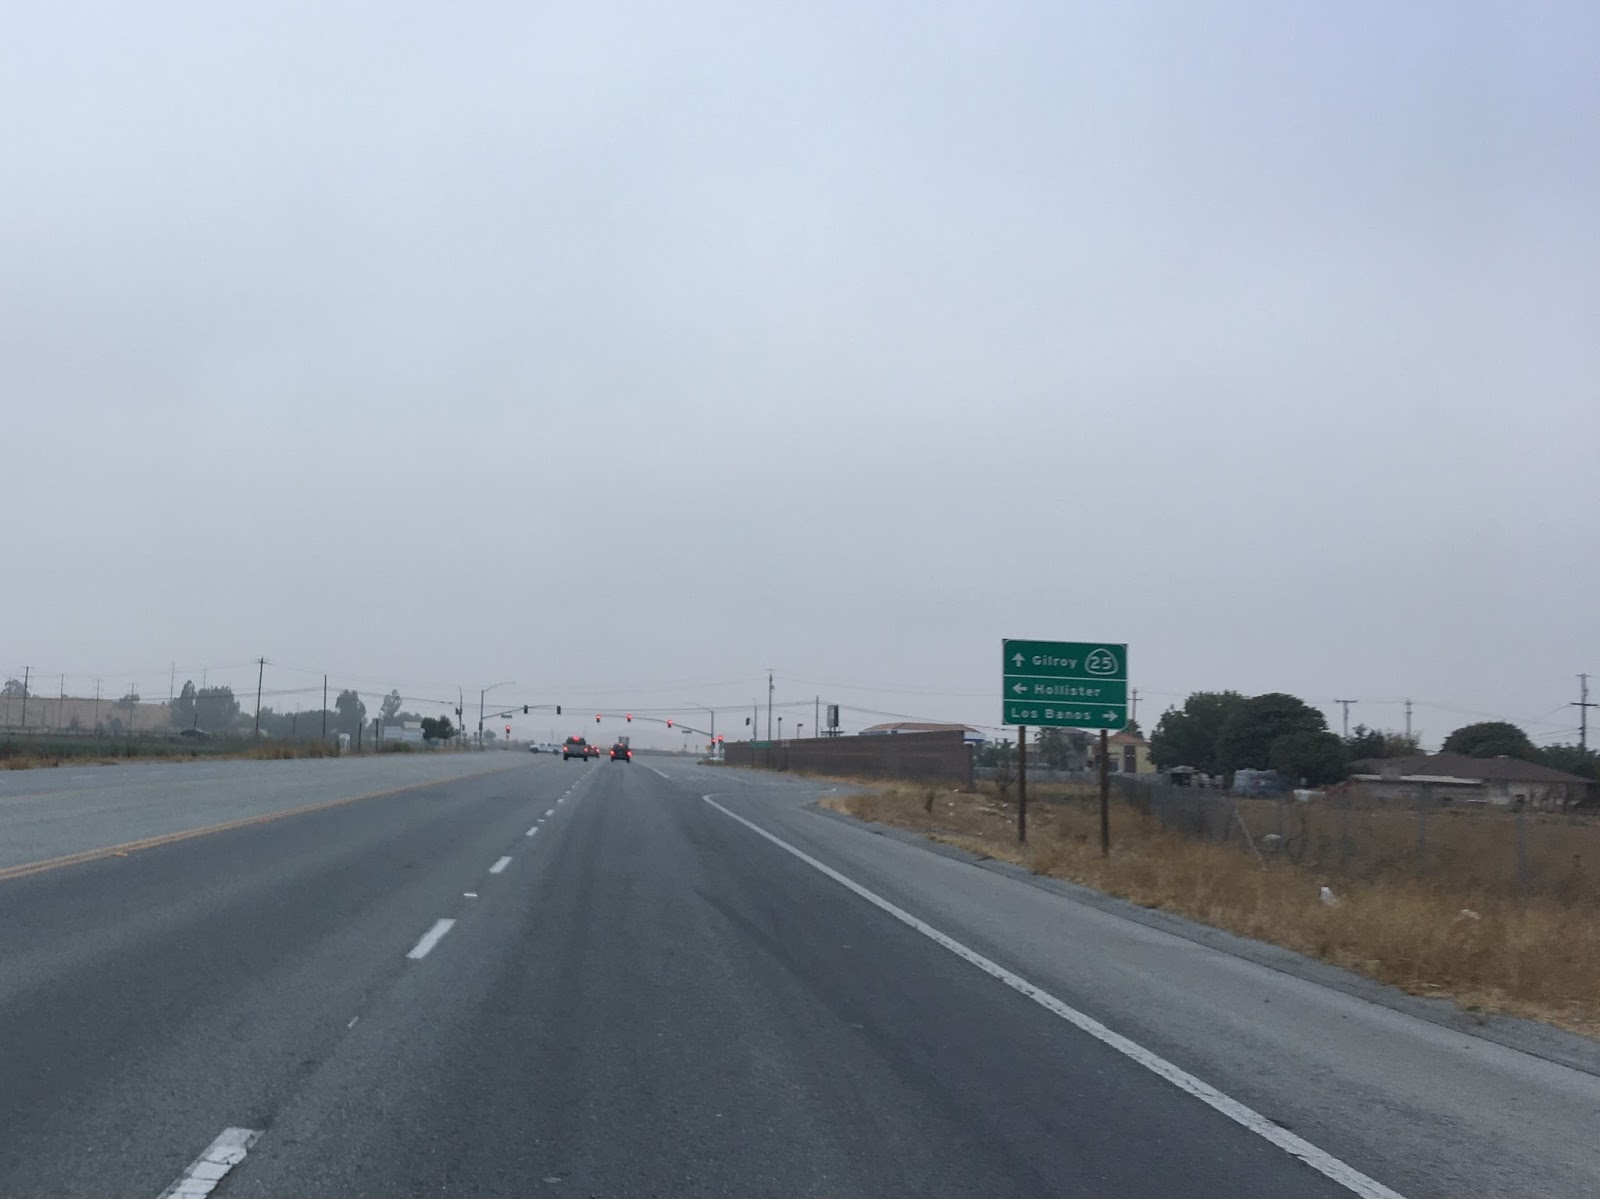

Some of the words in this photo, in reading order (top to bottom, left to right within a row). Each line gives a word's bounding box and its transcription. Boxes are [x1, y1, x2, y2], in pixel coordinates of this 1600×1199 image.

[1032, 655, 1078, 669] Gilroy
[1090, 656, 1112, 670] 25
[1034, 685, 1101, 696] Hollister
[1011, 708, 1038, 718] Los
[1045, 709, 1091, 720] Banos
